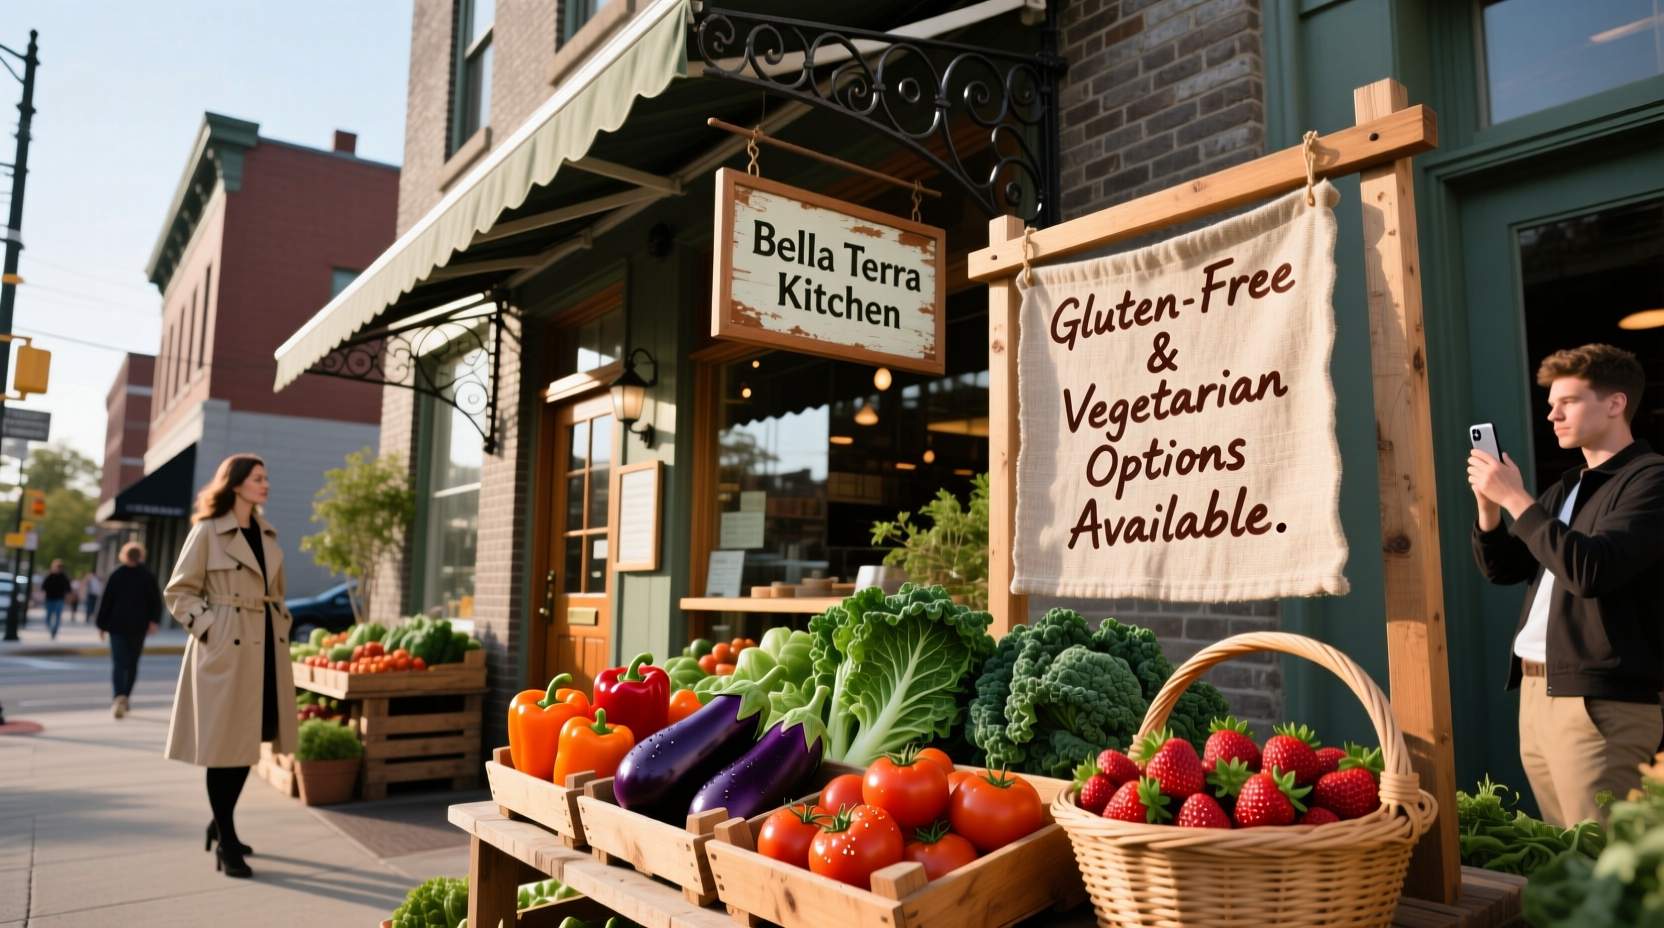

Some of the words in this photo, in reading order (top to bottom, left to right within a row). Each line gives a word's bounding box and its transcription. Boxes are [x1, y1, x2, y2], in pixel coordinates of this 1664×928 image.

[752, 219, 835, 272] Bella
[843, 242, 921, 292] Terra
[777, 272, 901, 329] Kitchen
[1050, 257, 1296, 351] Gluten-Free
[1146, 331, 1179, 374] &
[1063, 369, 1288, 442] Vegetarian
[1085, 437, 1247, 500] Options
[1067, 486, 1287, 550] Available.
